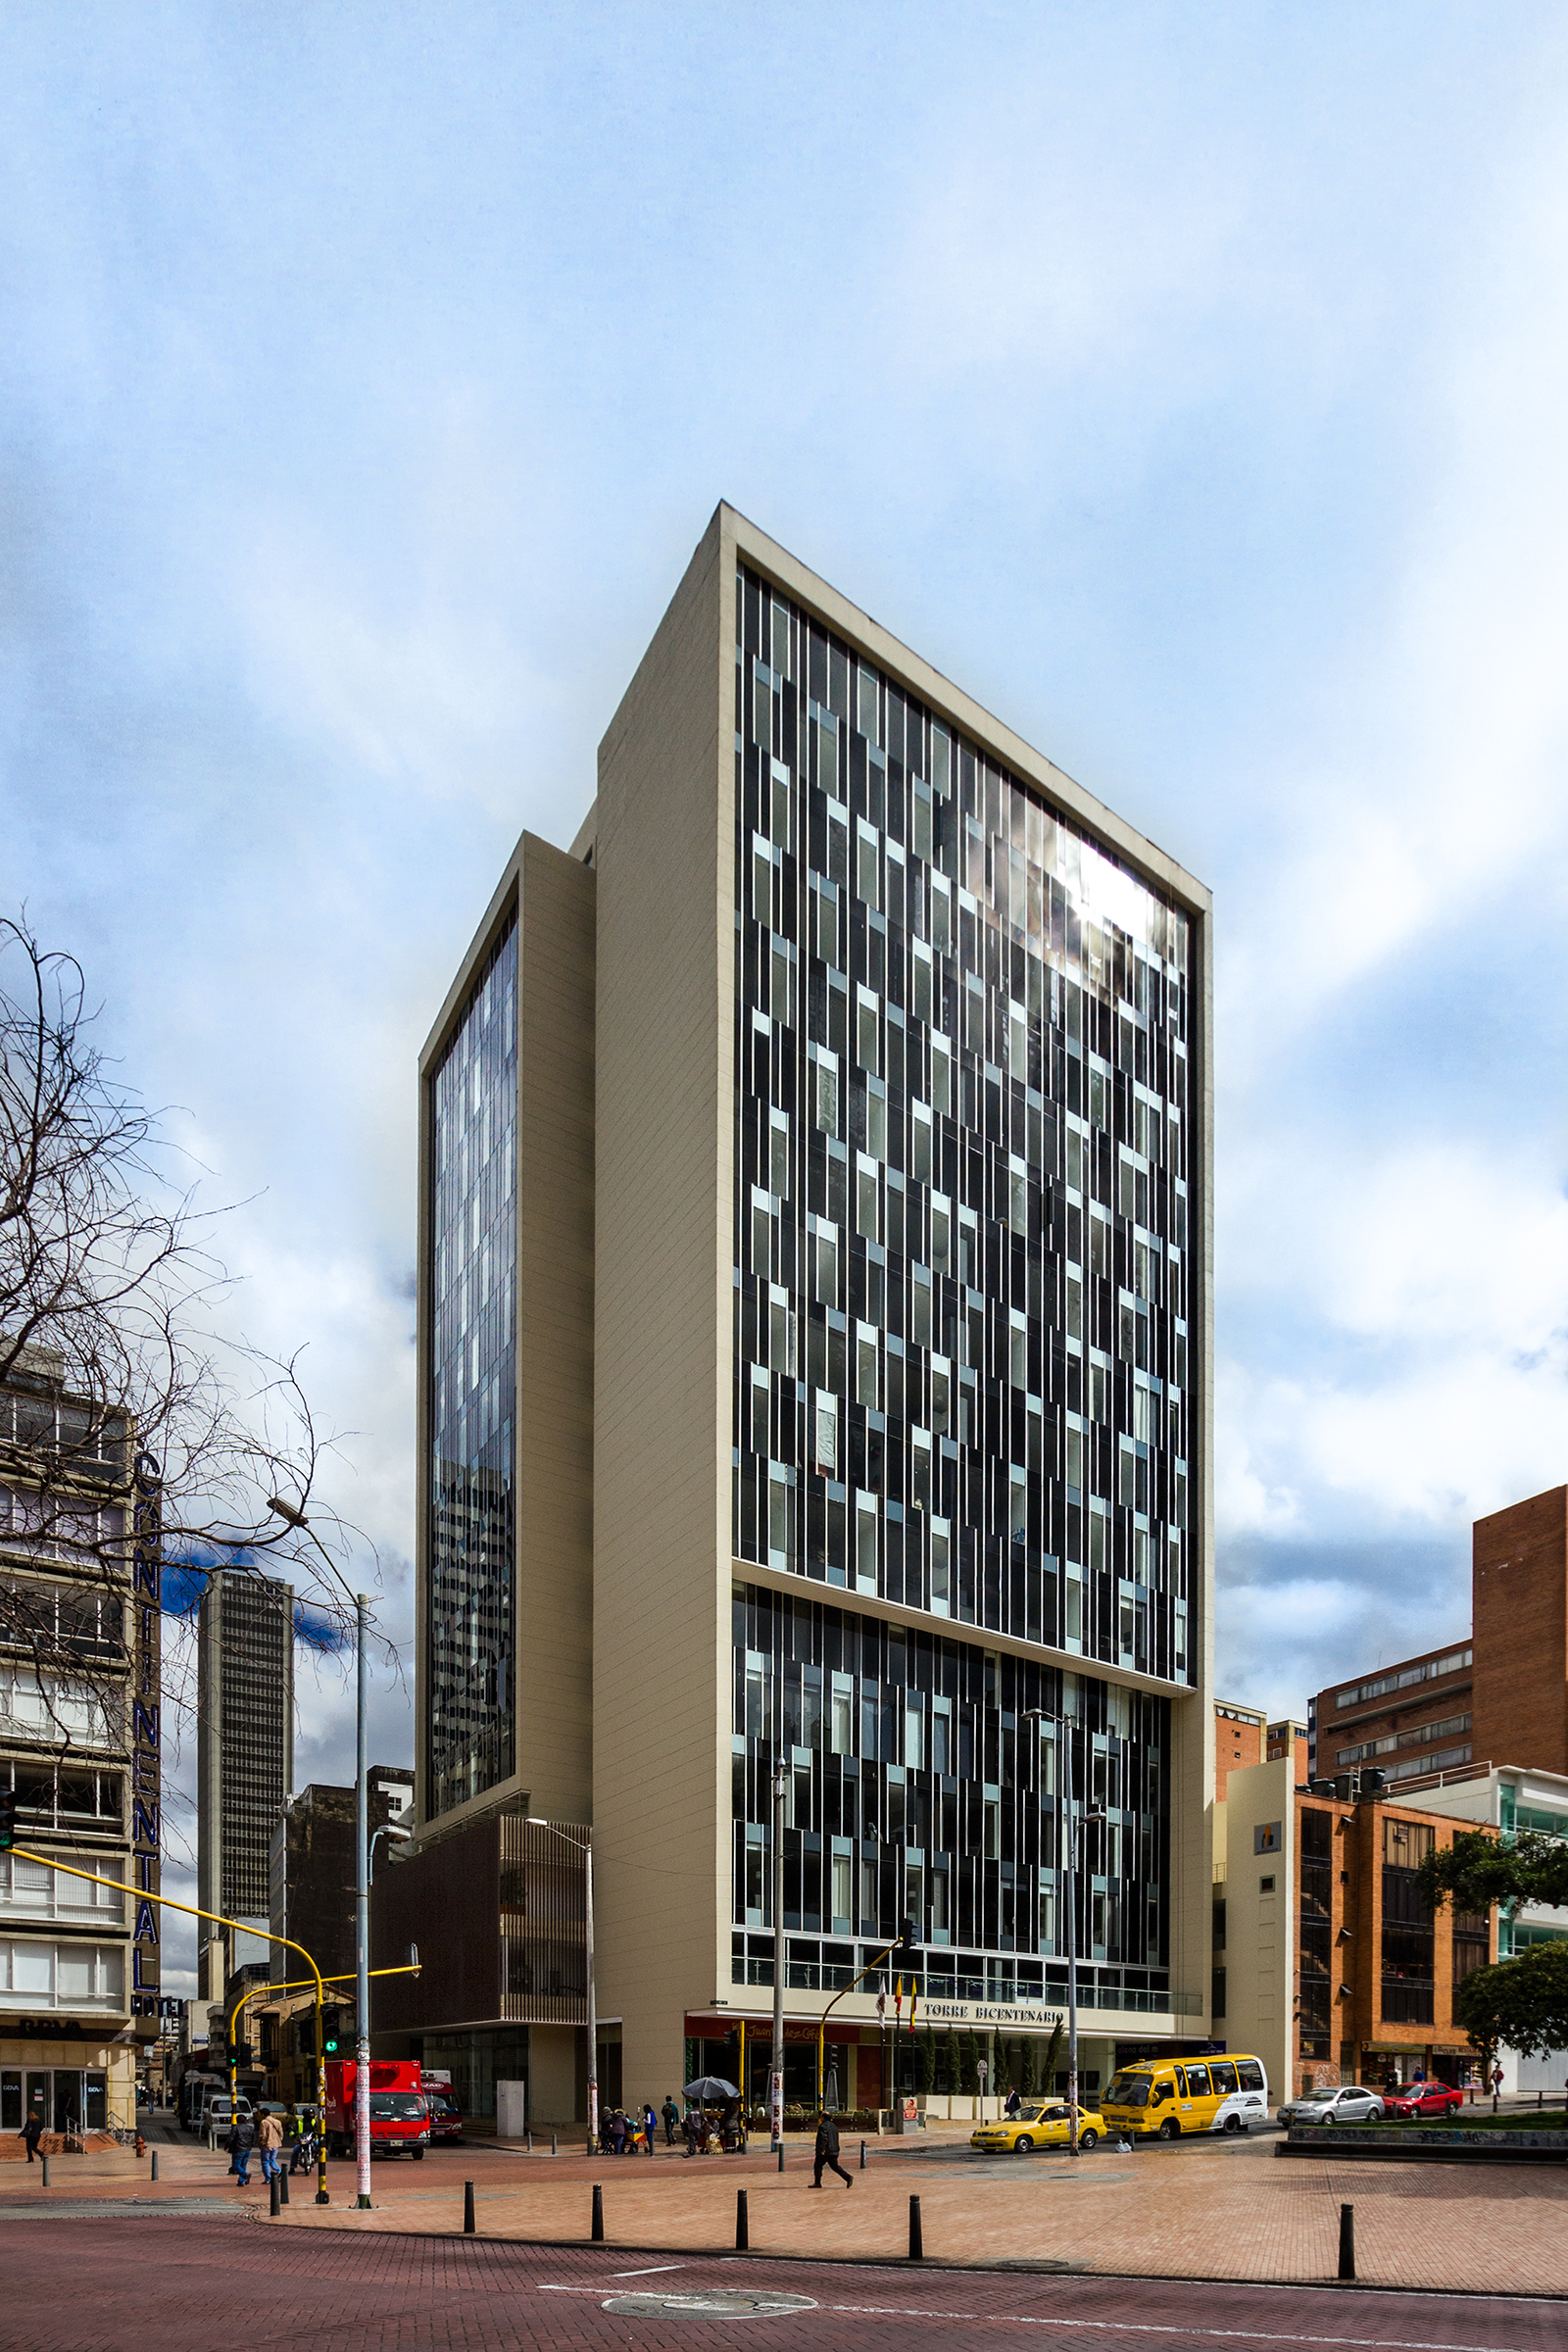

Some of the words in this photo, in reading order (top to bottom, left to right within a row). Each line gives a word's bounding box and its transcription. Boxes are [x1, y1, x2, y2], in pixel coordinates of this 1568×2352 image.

[133, 1451, 160, 1993] CONTINENTAL
[131, 1995, 188, 2019] HOTEL
[924, 2003, 968, 2019] TORRE
[975, 2006, 1064, 2024] BICENTENARIO
[746, 2024, 771, 2037] Juan
